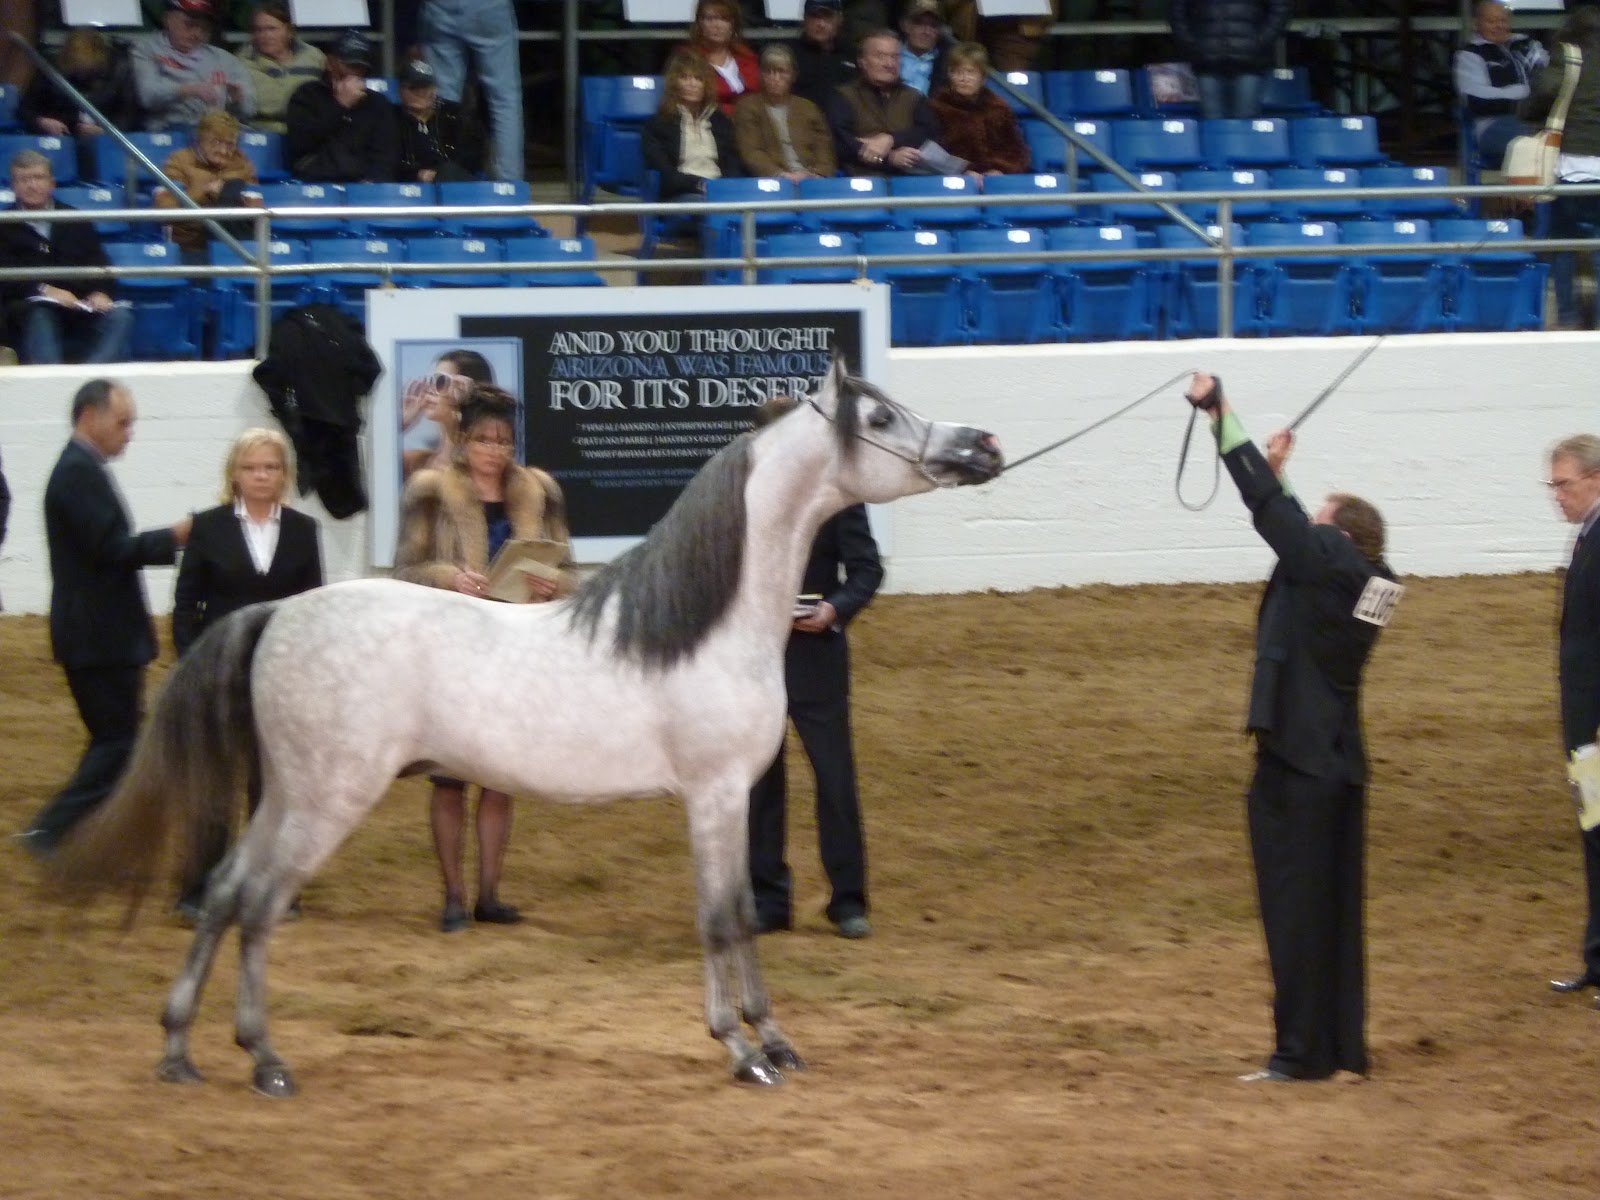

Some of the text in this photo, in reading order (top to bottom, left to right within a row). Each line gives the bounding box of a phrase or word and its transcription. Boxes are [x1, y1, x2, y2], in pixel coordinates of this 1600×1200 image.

[547, 327, 835, 355] AND YOU THOUGHT
[548, 352, 833, 378] ARIZONA WAS FAMOUS
[548, 380, 628, 410] FOR
[632, 378, 690, 409] ITS
